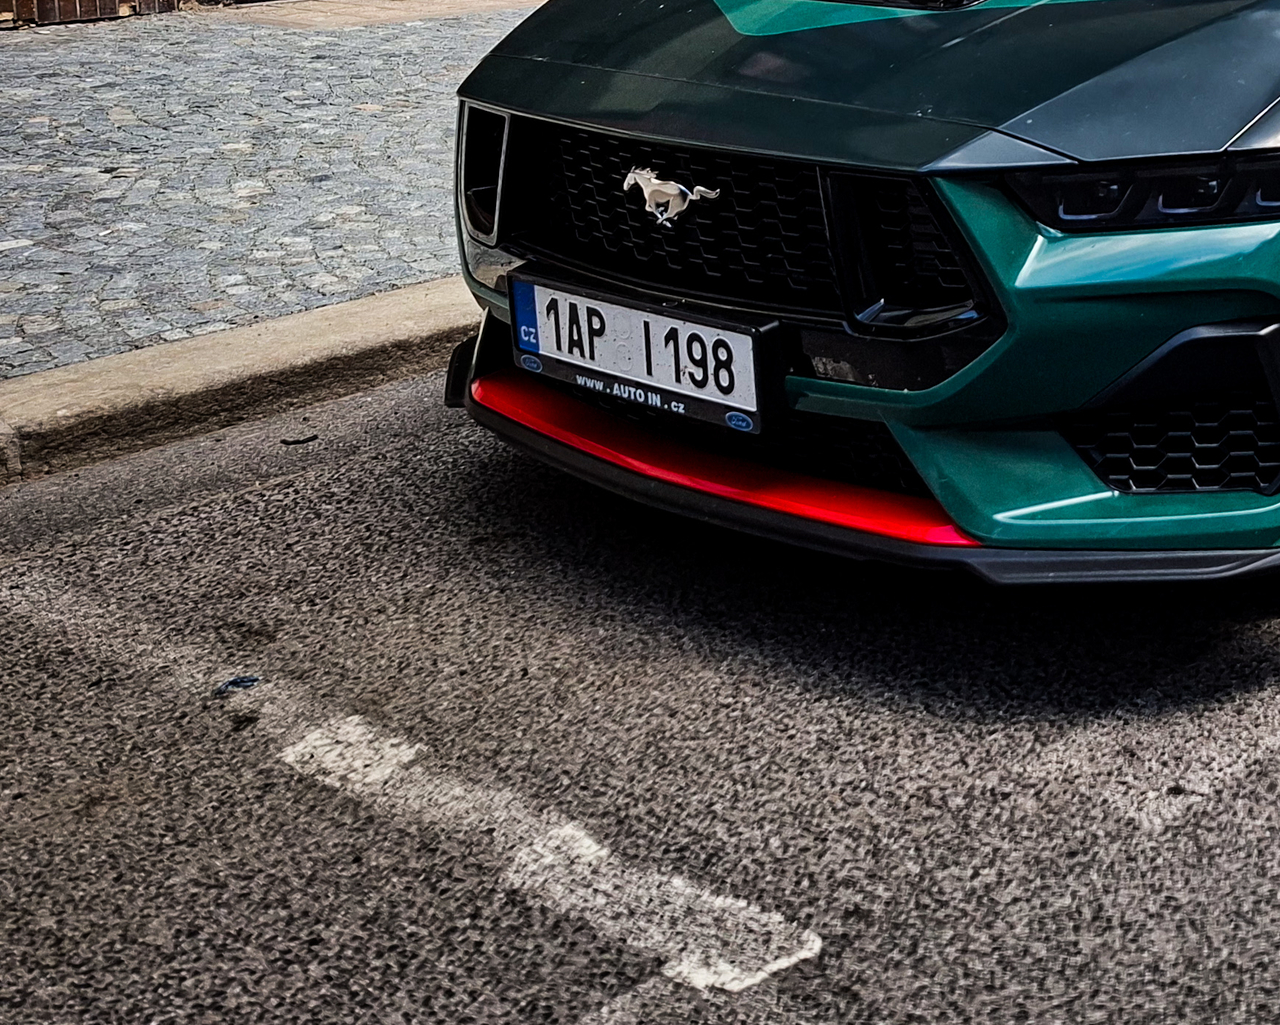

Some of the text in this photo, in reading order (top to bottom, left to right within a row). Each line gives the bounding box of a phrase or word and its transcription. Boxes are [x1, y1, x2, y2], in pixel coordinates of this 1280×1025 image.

[520, 326, 537, 344] CZ
[545, 297, 606, 361] 1AP
[612, 382, 645, 403] AUTO
[648, 392, 661, 407] IN
